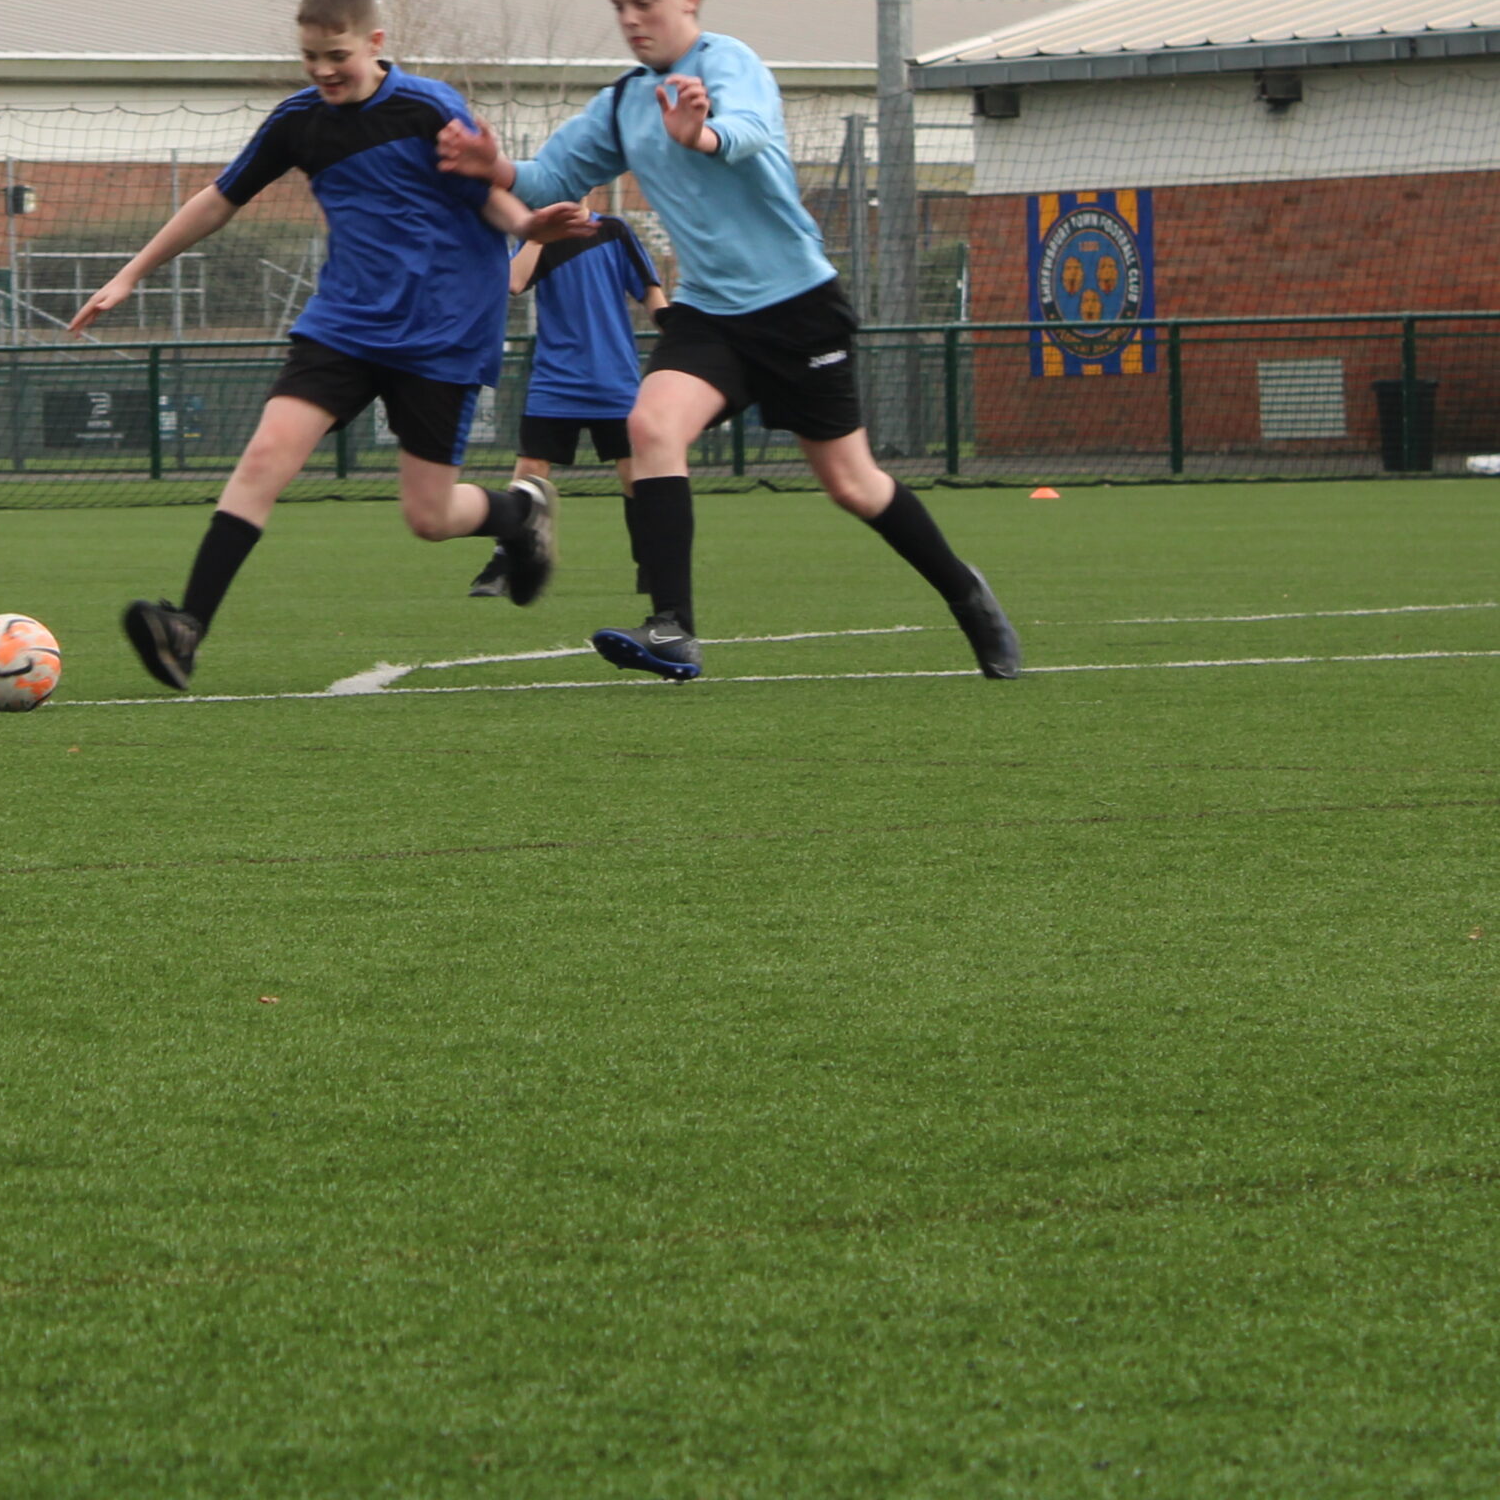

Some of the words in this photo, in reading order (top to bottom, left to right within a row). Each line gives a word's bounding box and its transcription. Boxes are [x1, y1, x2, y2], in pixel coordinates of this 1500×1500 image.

[1070, 213, 1099, 228] TOWN
[1100, 215, 1136, 266] FOOTBALL
[1128, 267, 1140, 303] CLUB
